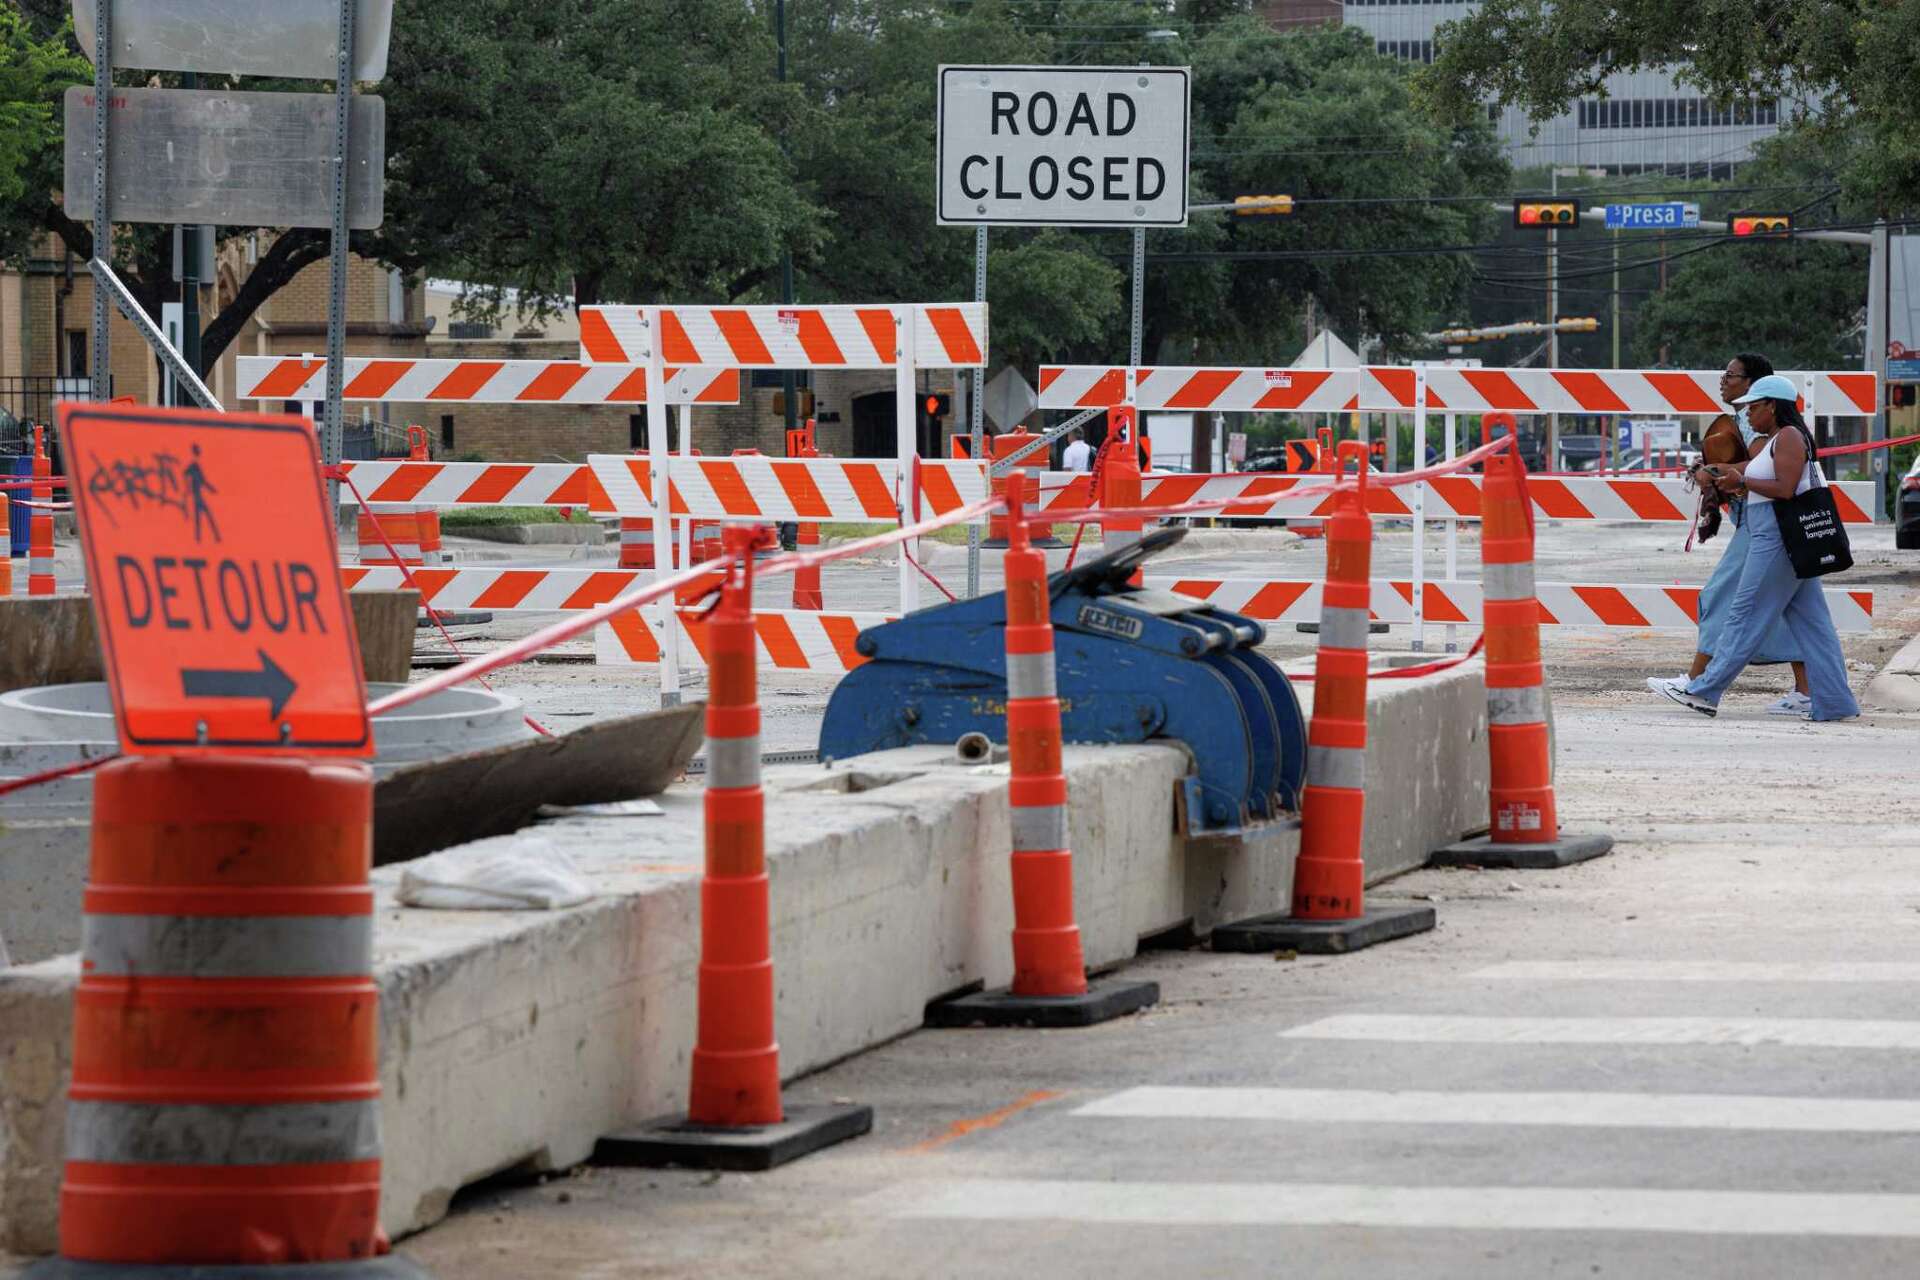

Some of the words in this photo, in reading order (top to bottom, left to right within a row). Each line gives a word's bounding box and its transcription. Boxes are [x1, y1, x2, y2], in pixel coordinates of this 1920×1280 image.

[991, 91, 1136, 136] ROAD
[960, 154, 1166, 201] CLOSED
[1622, 206, 1675, 224] Presa
[1799, 511, 1820, 523] Music
[1804, 516, 1833, 531] universal
[1805, 527, 1837, 540] language
[116, 555, 328, 634] DETOUR
